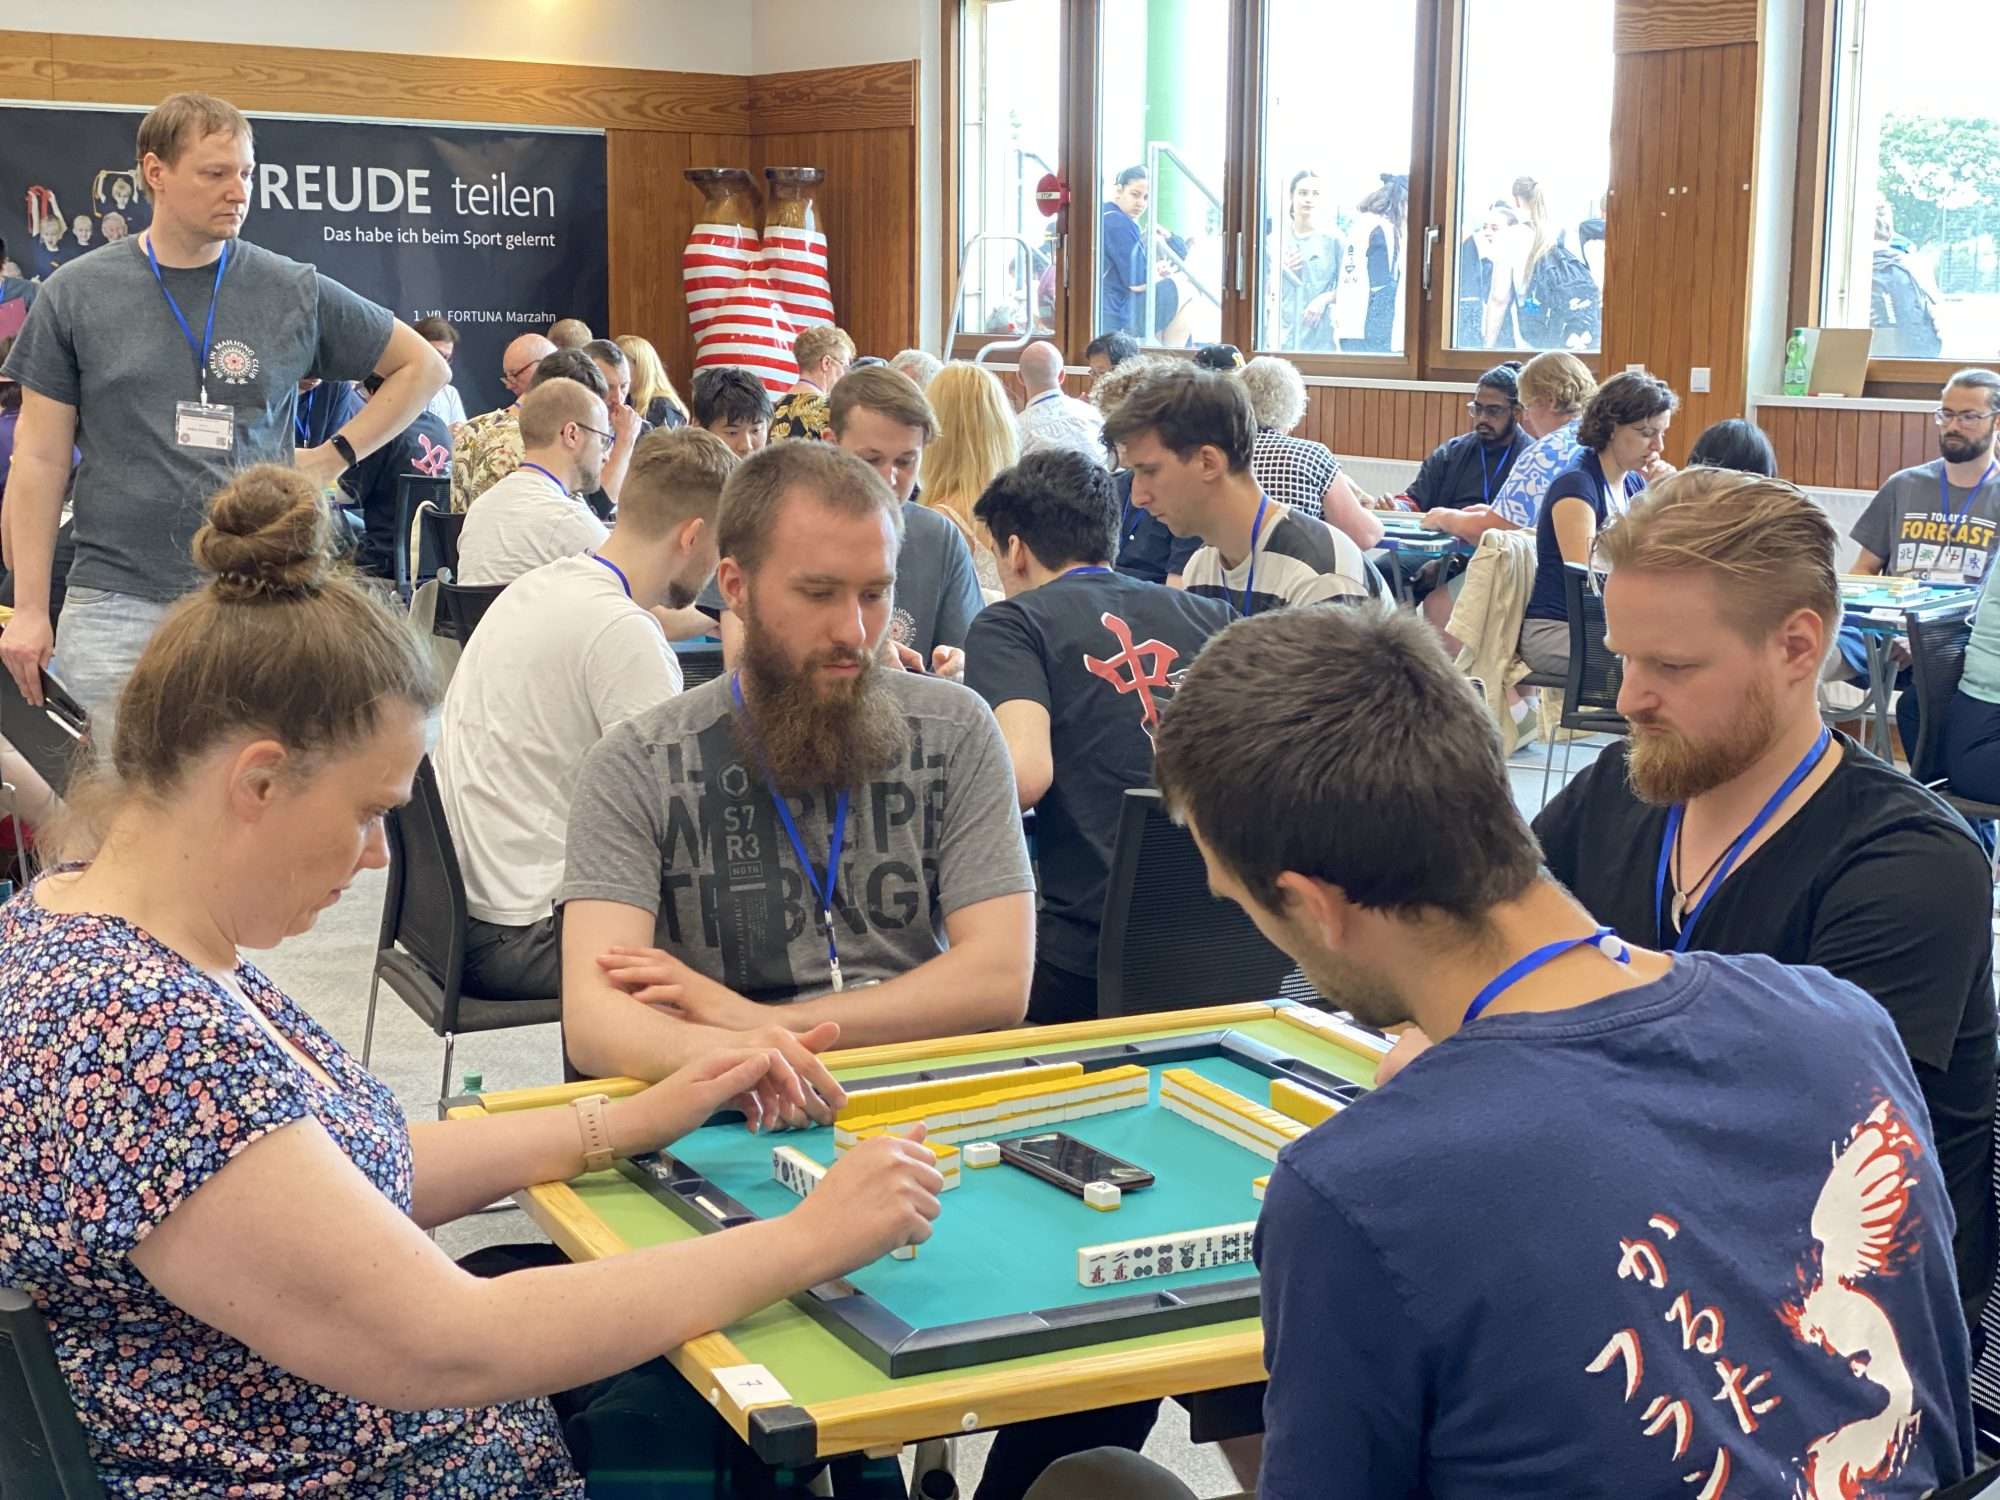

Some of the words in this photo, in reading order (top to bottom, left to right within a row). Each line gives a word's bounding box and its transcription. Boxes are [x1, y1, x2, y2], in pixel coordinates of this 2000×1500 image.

[259, 163, 432, 214] REUDE
[451, 172, 555, 217] teilen
[323, 226, 351, 241] Das
[356, 227, 393, 243] habe
[398, 228, 418, 244] ich
[422, 228, 459, 245] beim
[463, 230, 502, 249] Sport
[506, 231, 556, 250] gelernt
[447, 310, 503, 322] FORTUNA
[506, 311, 556, 323] Marzahn
[724, 805, 755, 832] S7
[725, 833, 760, 861] R3
